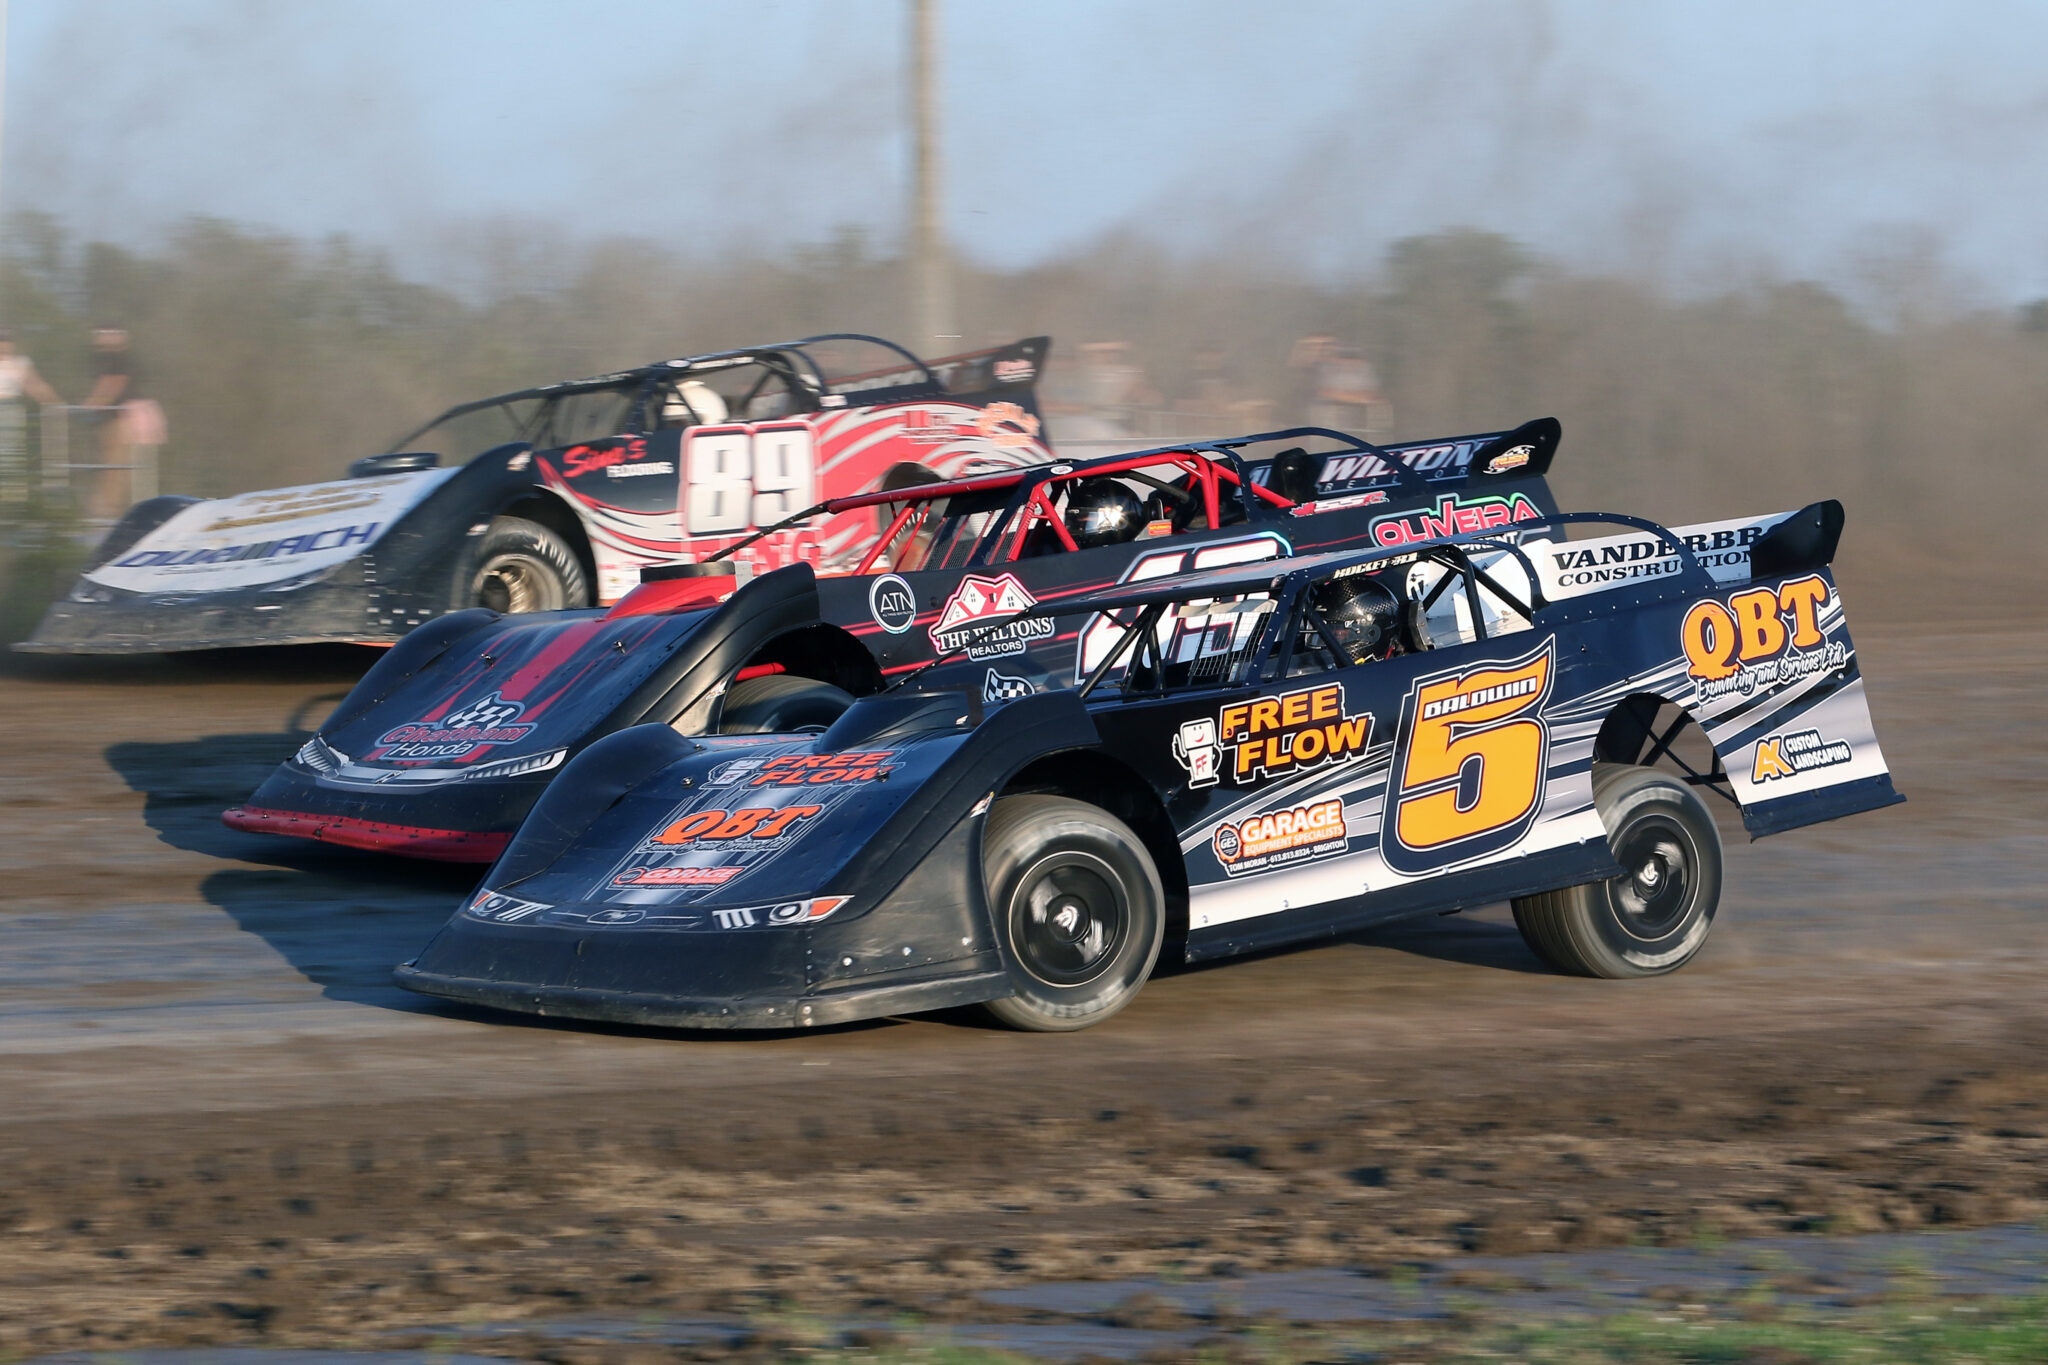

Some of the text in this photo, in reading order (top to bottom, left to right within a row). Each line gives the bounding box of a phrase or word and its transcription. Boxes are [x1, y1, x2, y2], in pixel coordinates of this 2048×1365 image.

[685, 430, 814, 536] 89
[1375, 500, 1539, 546] OLIVEIRA
[879, 591, 915, 613] ATN
[936, 617, 1053, 651] THE WILTONS
[1682, 576, 1828, 681] QBT
[971, 640, 1023, 657] REALTORS
[1696, 669, 1756, 699] Excavating
[1756, 661, 1779, 685] and
[1779, 653, 1820, 681] Services
[1221, 685, 1340, 740] FREE
[1422, 675, 1538, 722] BALDWIN
[383, 725, 530, 743] Chatham
[388, 740, 474, 757] Honda
[1236, 716, 1369, 774] FLOW
[1397, 653, 1551, 848] 5
[1784, 732, 1823, 754] CUSTOM
[761, 751, 895, 769] FREE
[1194, 753, 1209, 776] FF
[1753, 737, 1796, 782] AK
[1789, 744, 1850, 769] LANDSCAPING
[751, 765, 896, 785] FLOW
[651, 804, 823, 845] QBT
[1241, 802, 1341, 842] GARAGE
[1220, 836, 1237, 850] GES
[1228, 861, 1244, 873] TOM
[1313, 839, 1345, 854] BRIGHTON
[1244, 825, 1345, 855] EQUIPMENT SPECIALISTS
[643, 867, 739, 879] GARAGE
